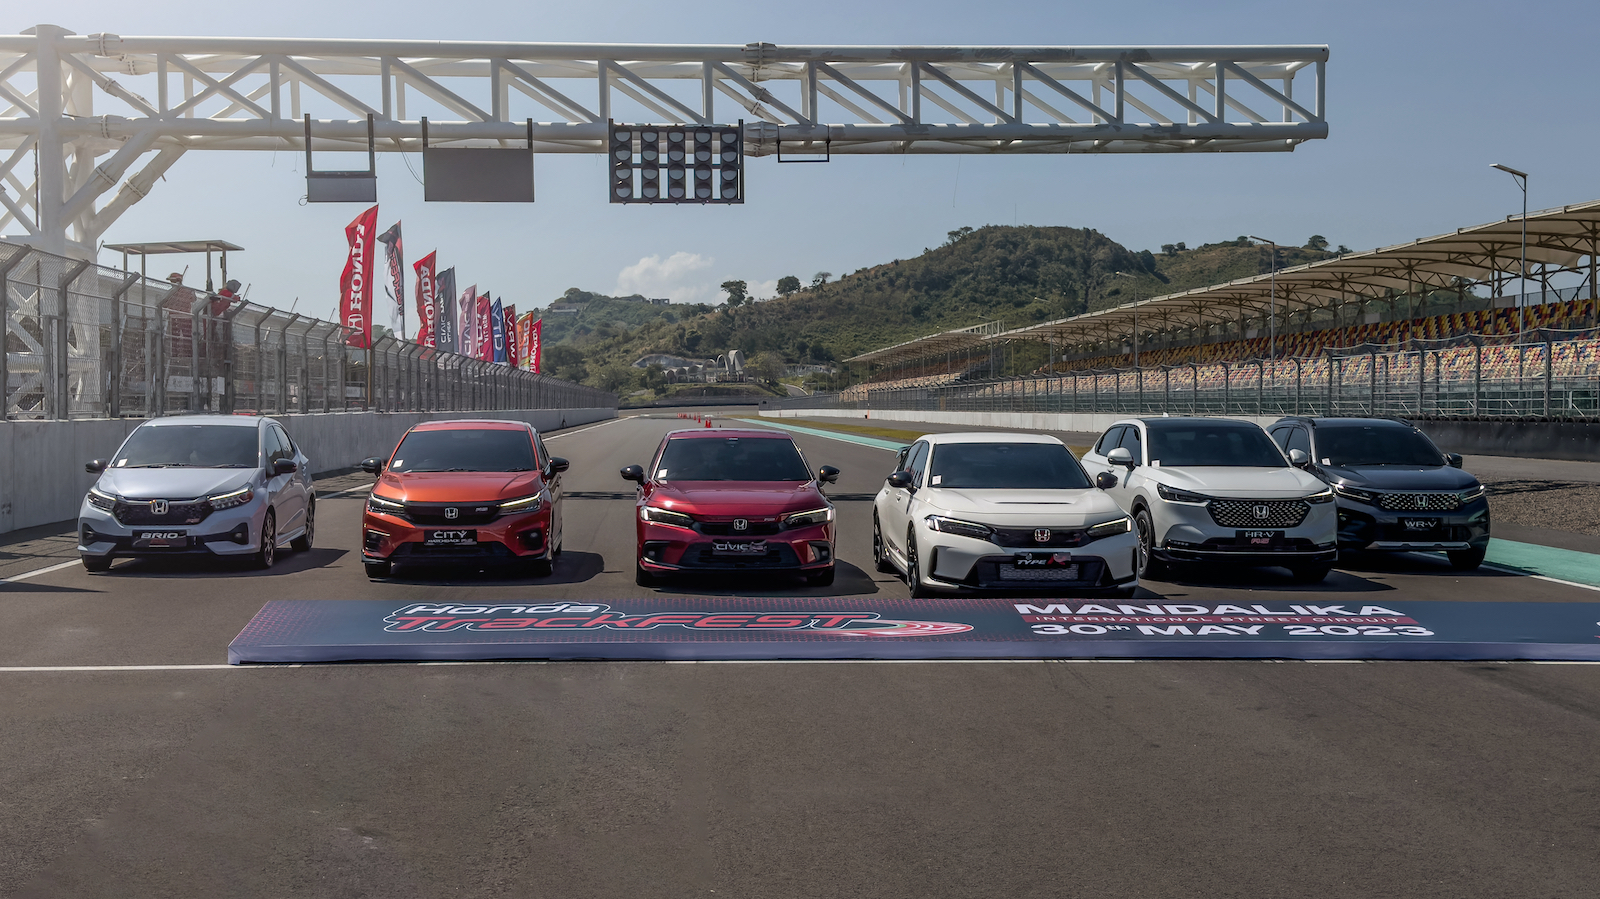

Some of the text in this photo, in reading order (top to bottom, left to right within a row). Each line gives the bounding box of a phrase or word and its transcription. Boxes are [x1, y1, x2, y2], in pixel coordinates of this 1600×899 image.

[716, 543, 750, 551] CIVIC
[404, 603, 600, 615] Honda
[1013, 603, 1406, 616] MANDALIKA
[1031, 624, 1435, 636] 30th MAY 2023
